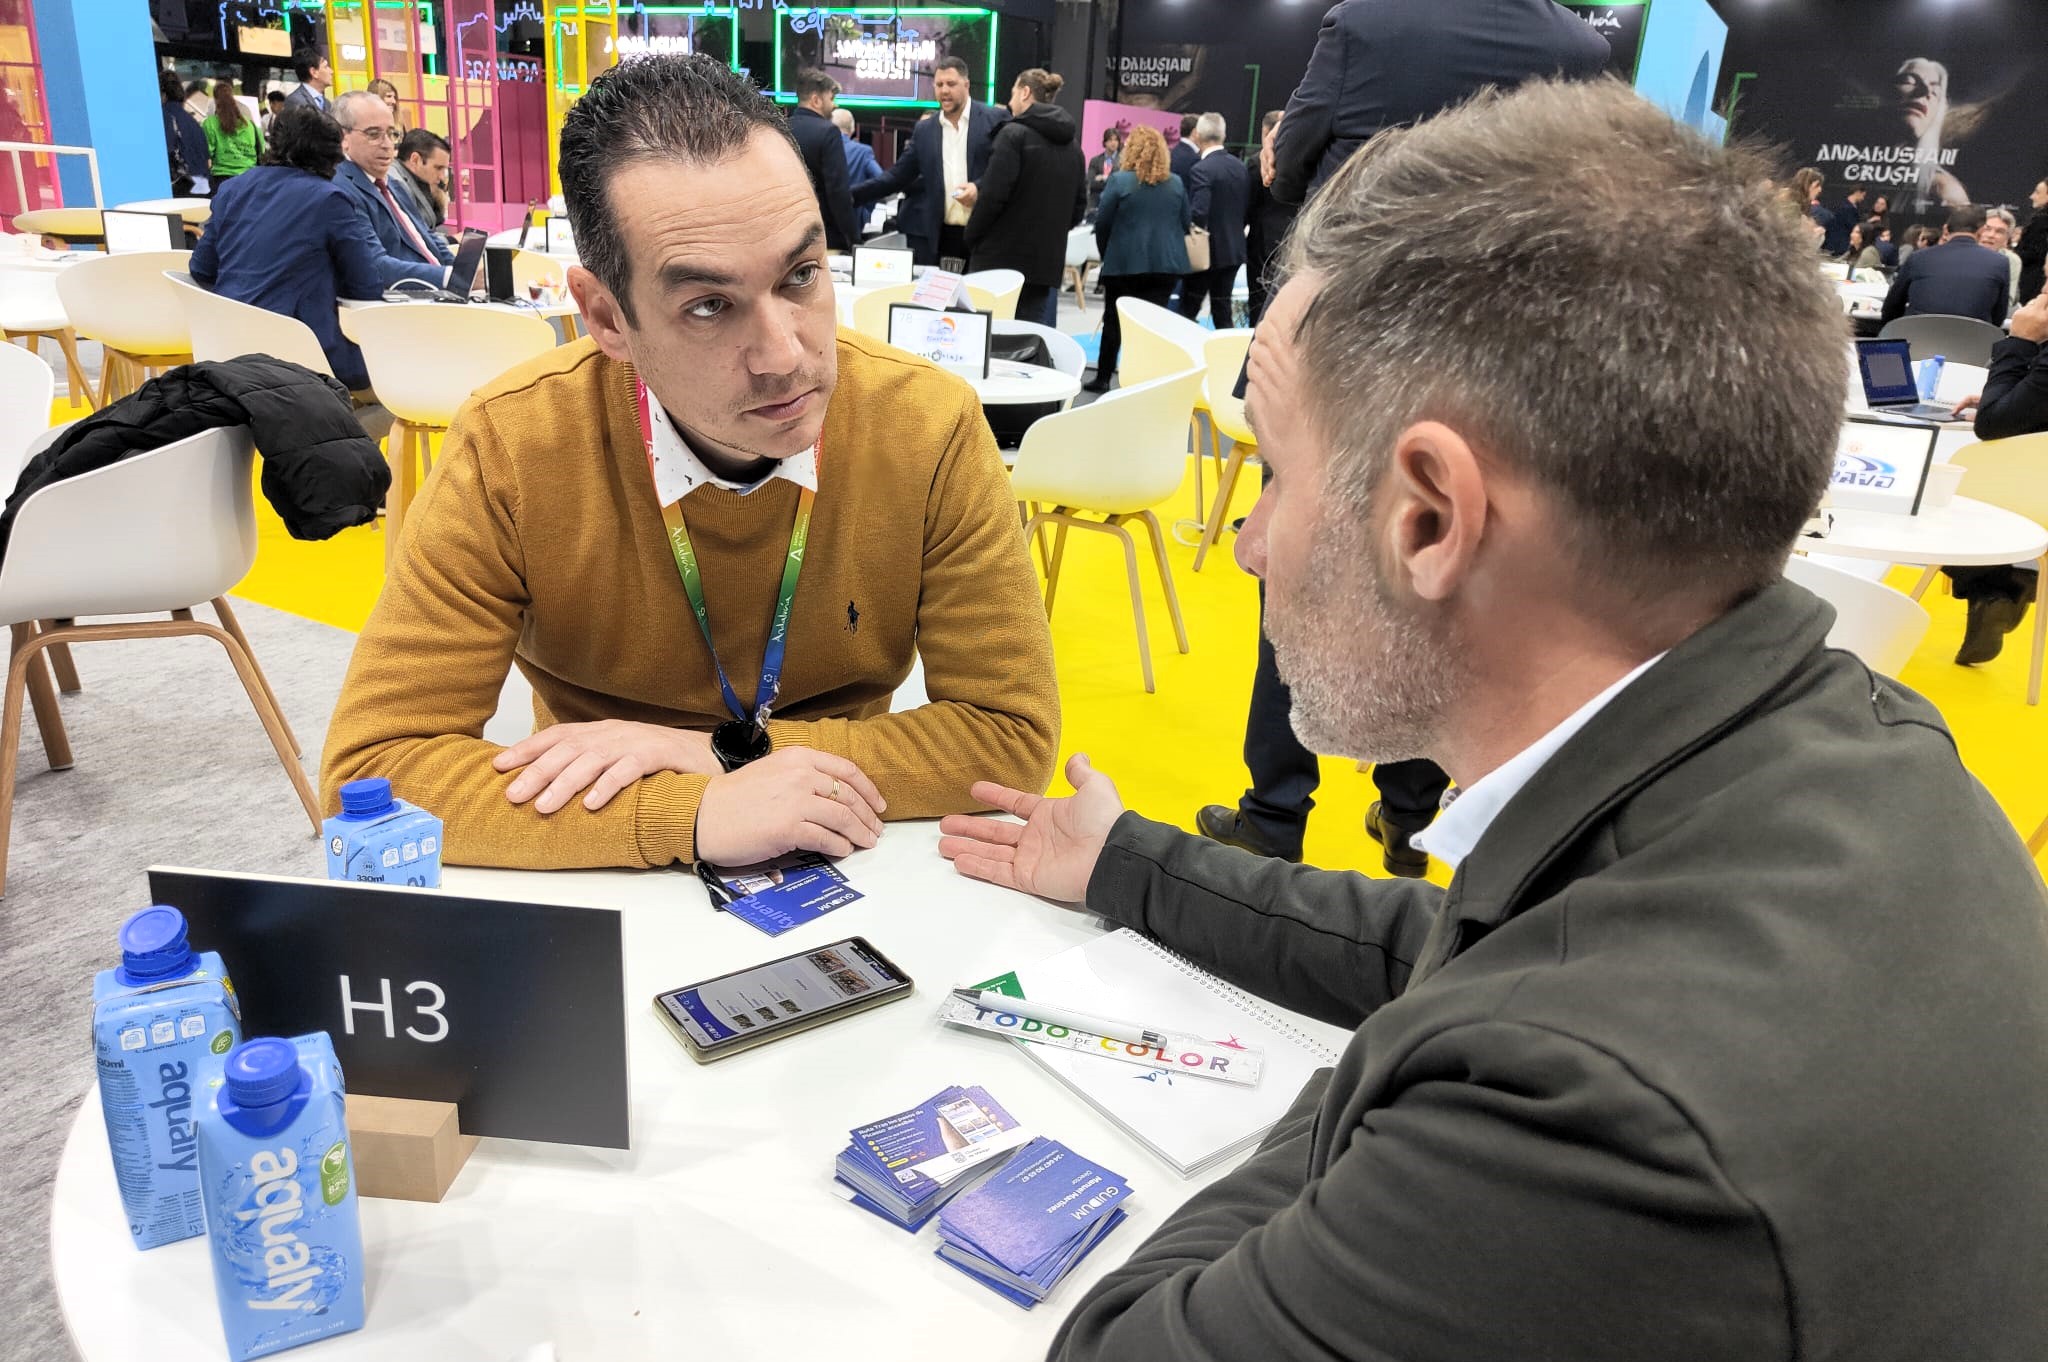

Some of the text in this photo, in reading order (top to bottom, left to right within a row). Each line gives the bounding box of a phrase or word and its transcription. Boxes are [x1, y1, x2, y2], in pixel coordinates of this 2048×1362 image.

[1815, 143, 1960, 166] ANDALUSIAN
[1844, 164, 1921, 186] CRUSH
[340, 974, 449, 1042] H3
[974, 1004, 1070, 1039] TODO
[1100, 1036, 1230, 1073] COLOR
[148, 1060, 198, 1171] aqualy
[1070, 1186, 1120, 1221] GUIDUM
[1077, 1174, 1103, 1196] Manuel
[234, 1147, 324, 1311] aqualy
